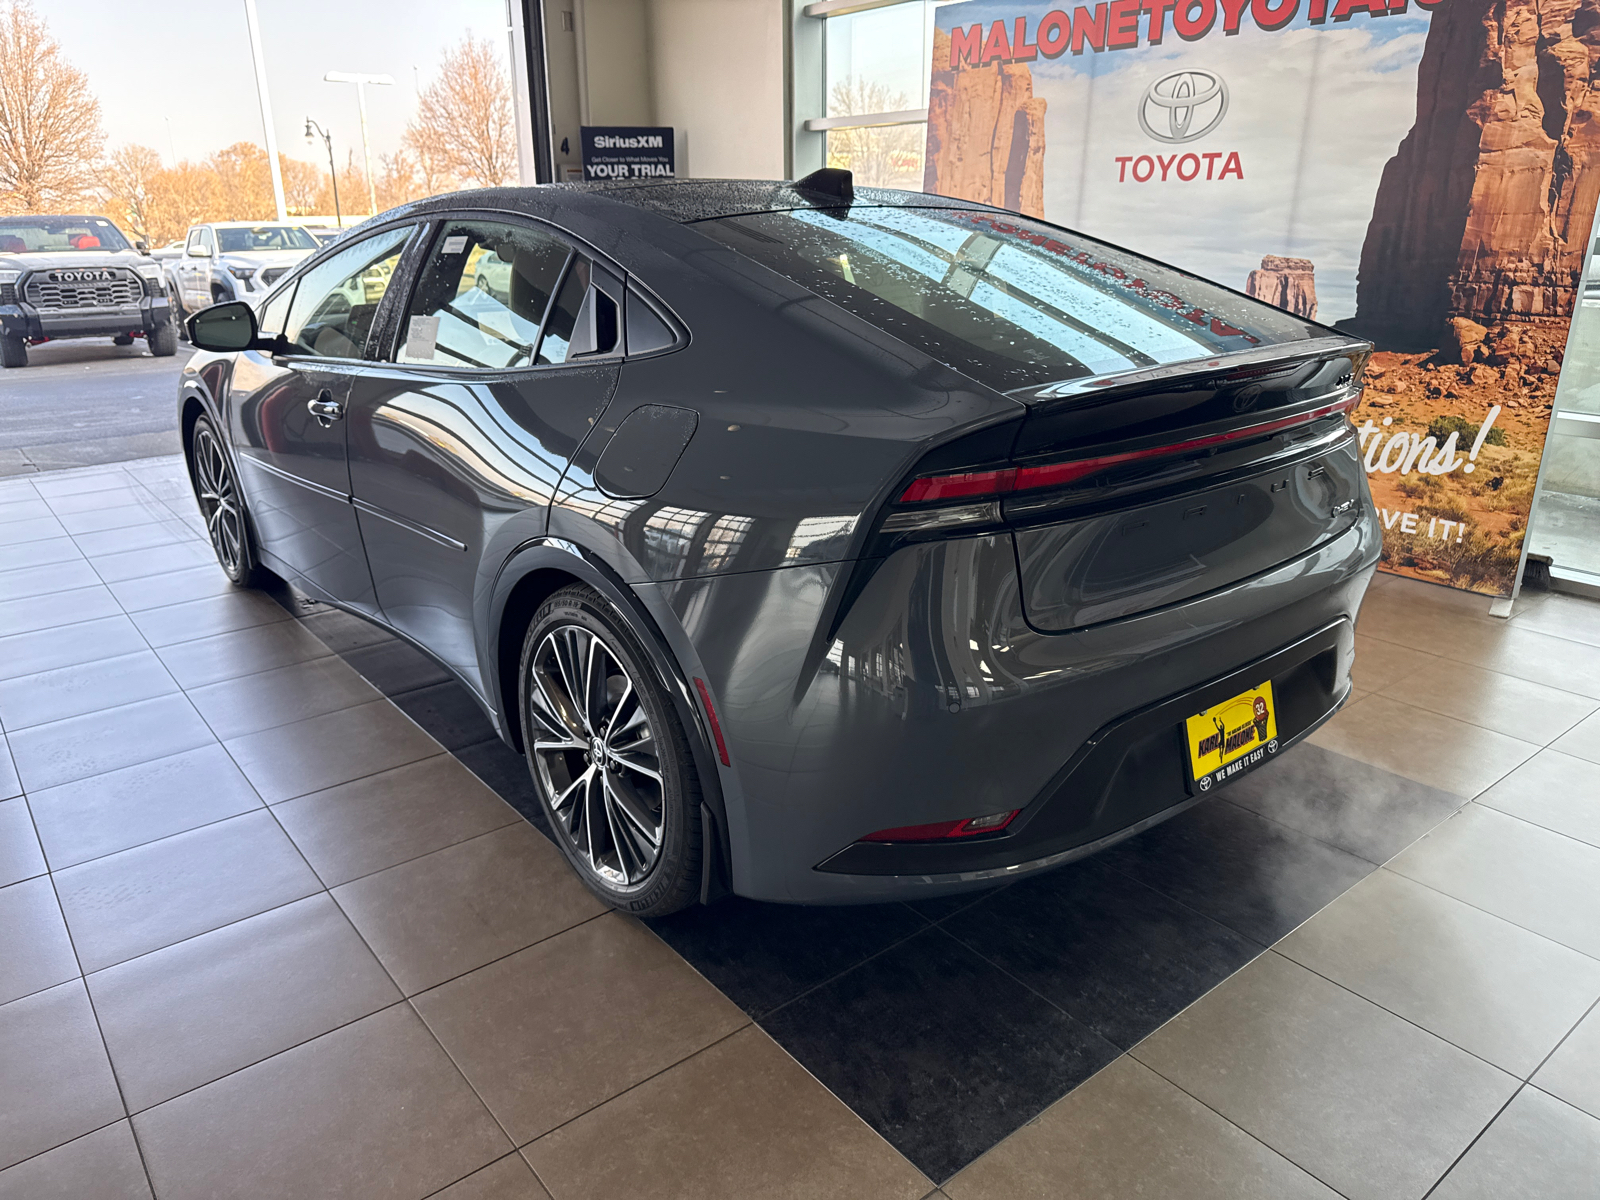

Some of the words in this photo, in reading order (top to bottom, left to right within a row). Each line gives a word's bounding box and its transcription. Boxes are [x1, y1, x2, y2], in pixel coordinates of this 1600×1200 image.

[949, 0, 1446, 70] MALONETOYO
[560, 137, 570, 155] 4
[594, 135, 663, 148] SiriusXM
[586, 164, 629, 177] YOUR
[631, 164, 675, 177] TRIAL
[1115, 151, 1244, 183] TOYOTA
[55, 271, 112, 282] TOYOTA
[1375, 507, 1419, 534] VE
[1428, 517, 1466, 544] IT!
[1255, 702, 1265, 716] 32
[1198, 732, 1220, 759] KARL
[1224, 724, 1256, 755] MALONE
[1215, 769, 1226, 782] WE
[1226, 760, 1243, 777] MAKE
[1243, 756, 1249, 767] IT
[1250, 748, 1264, 764] EASY
